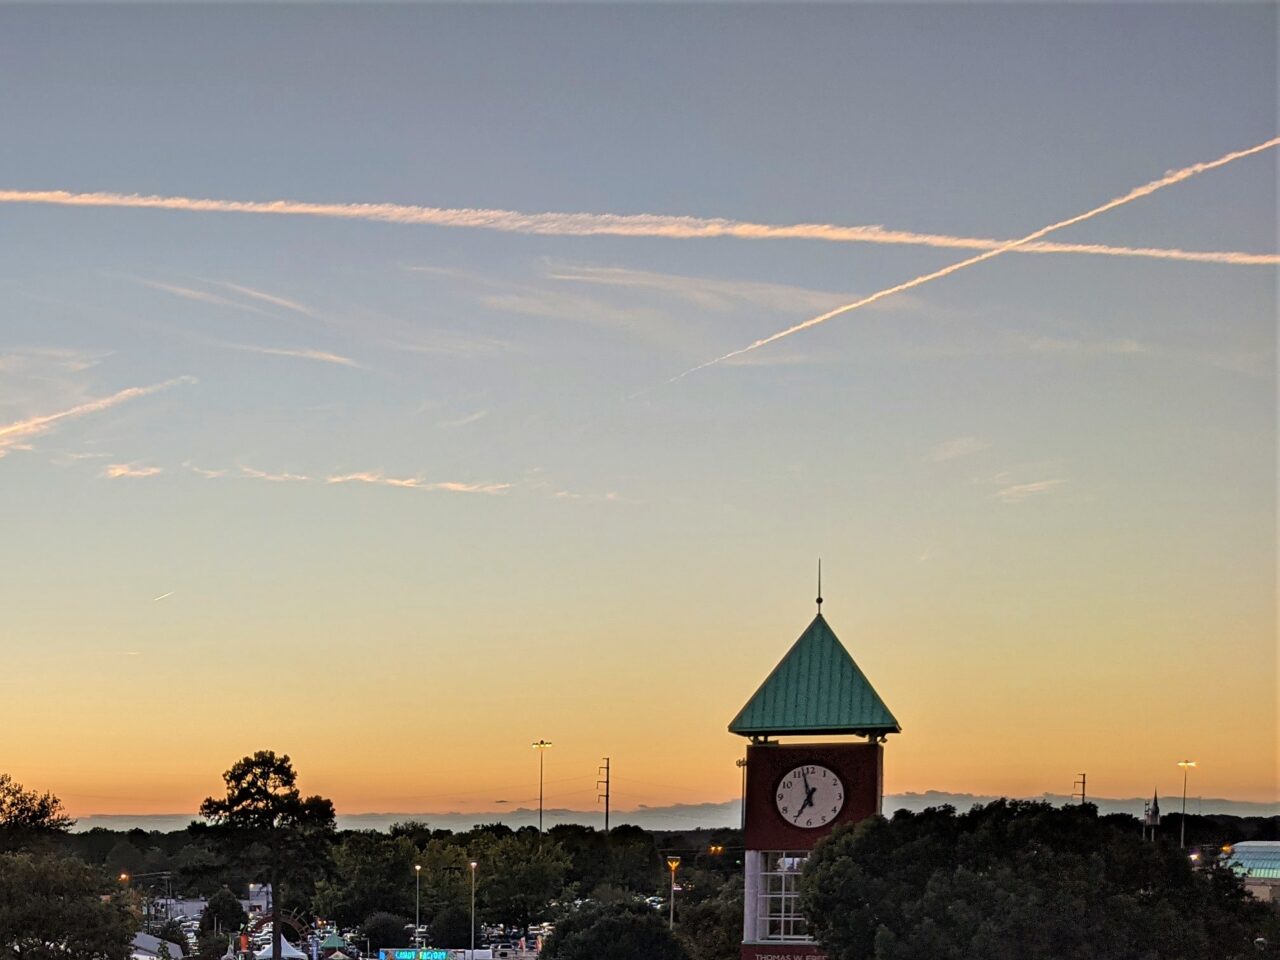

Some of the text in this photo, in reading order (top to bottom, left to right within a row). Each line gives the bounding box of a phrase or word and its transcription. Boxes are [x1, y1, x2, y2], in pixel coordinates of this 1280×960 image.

[805, 766, 816, 775] 12
[822, 770, 827, 778] 1
[792, 771, 801, 779] 11
[782, 781, 793, 789] 10
[832, 778, 838, 786] 2
[777, 793, 784, 802] 9
[781, 806, 788, 814] 8
[831, 806, 837, 814] 4
[806, 819, 812, 827] 6
